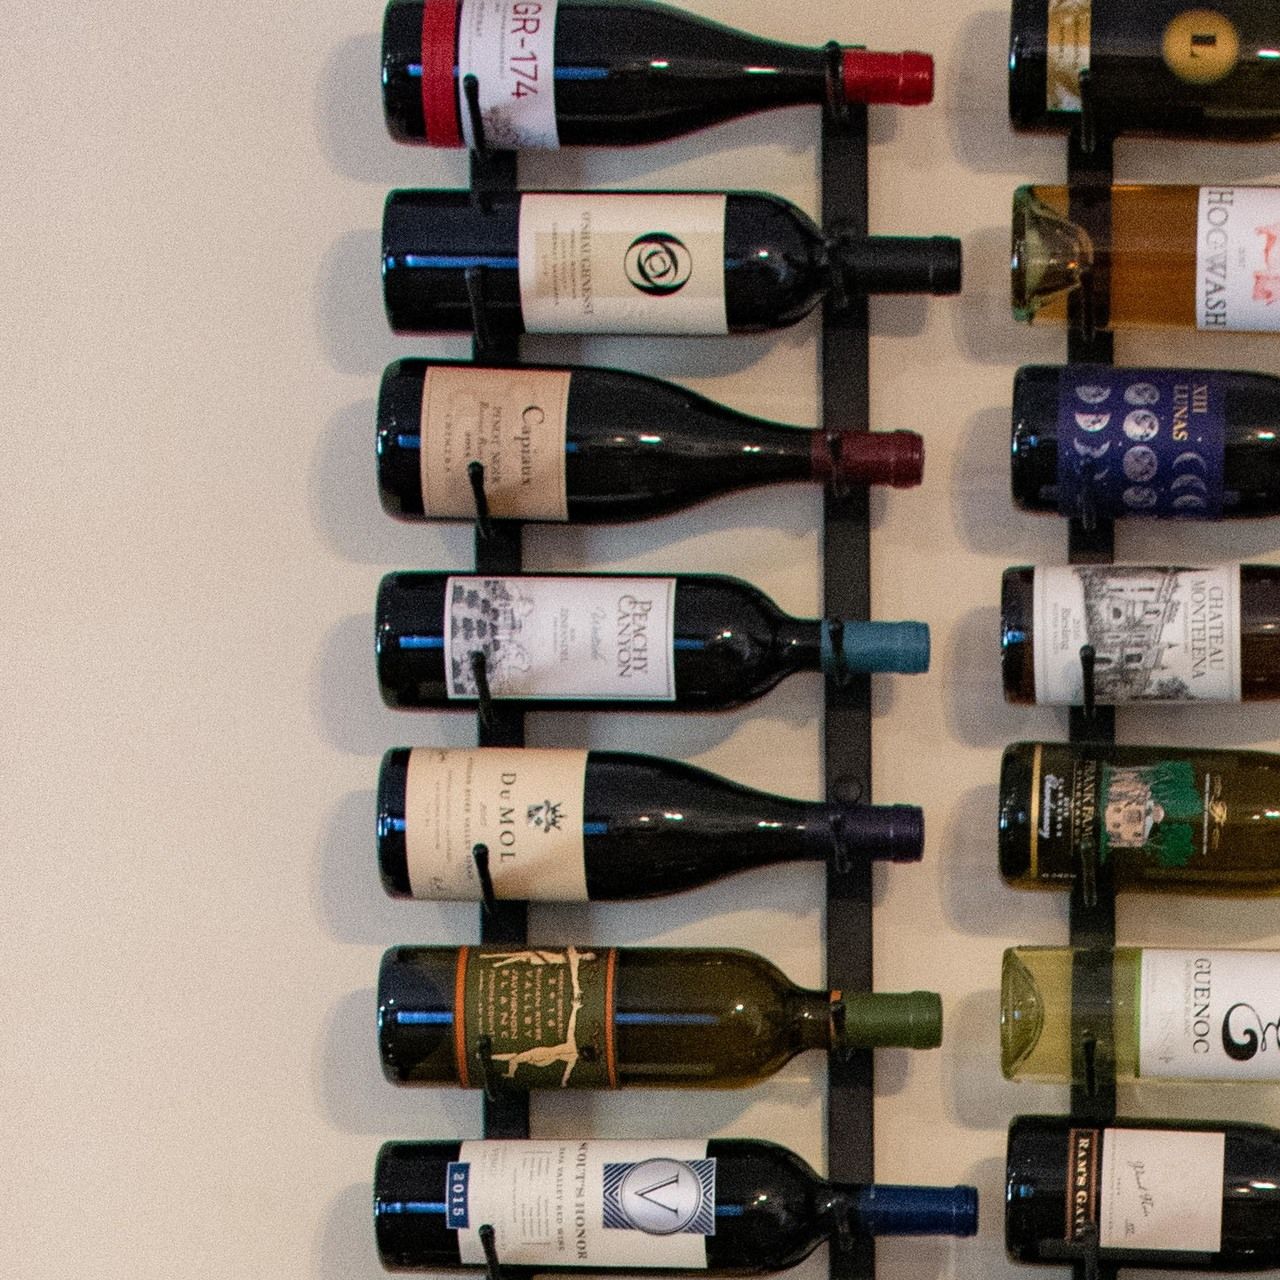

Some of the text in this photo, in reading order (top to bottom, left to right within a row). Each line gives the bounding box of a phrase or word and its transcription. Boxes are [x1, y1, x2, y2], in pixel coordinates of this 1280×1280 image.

[510, 3, 542, 98] GR-174
[1204, 189, 1235, 328] HOGWASH
[514, 405, 545, 487] Capiaux
[1171, 385, 1189, 442] LUNAS
[617, 595, 638, 678] CANYON
[629, 600, 653, 674] PEACHY
[1189, 580, 1207, 680] MONTELENA
[1206, 586, 1225, 671] CHATEAU
[500, 969, 509, 1039] BLANC
[510, 969, 518, 1040] SAUVIGNON
[524, 969, 533, 1038] VALLEY
[1193, 958, 1212, 1054] GUENOC
[453, 1172, 465, 1218] 2015
[556, 1167, 564, 1201] VALLEY
[634, 1171, 680, 1218] V
[1076, 1137, 1091, 1187] RAM'S
[556, 1204, 564, 1225] RED
[575, 1142, 589, 1260] SCOUT'S HONOR
[557, 1227, 565, 1252] WINE
